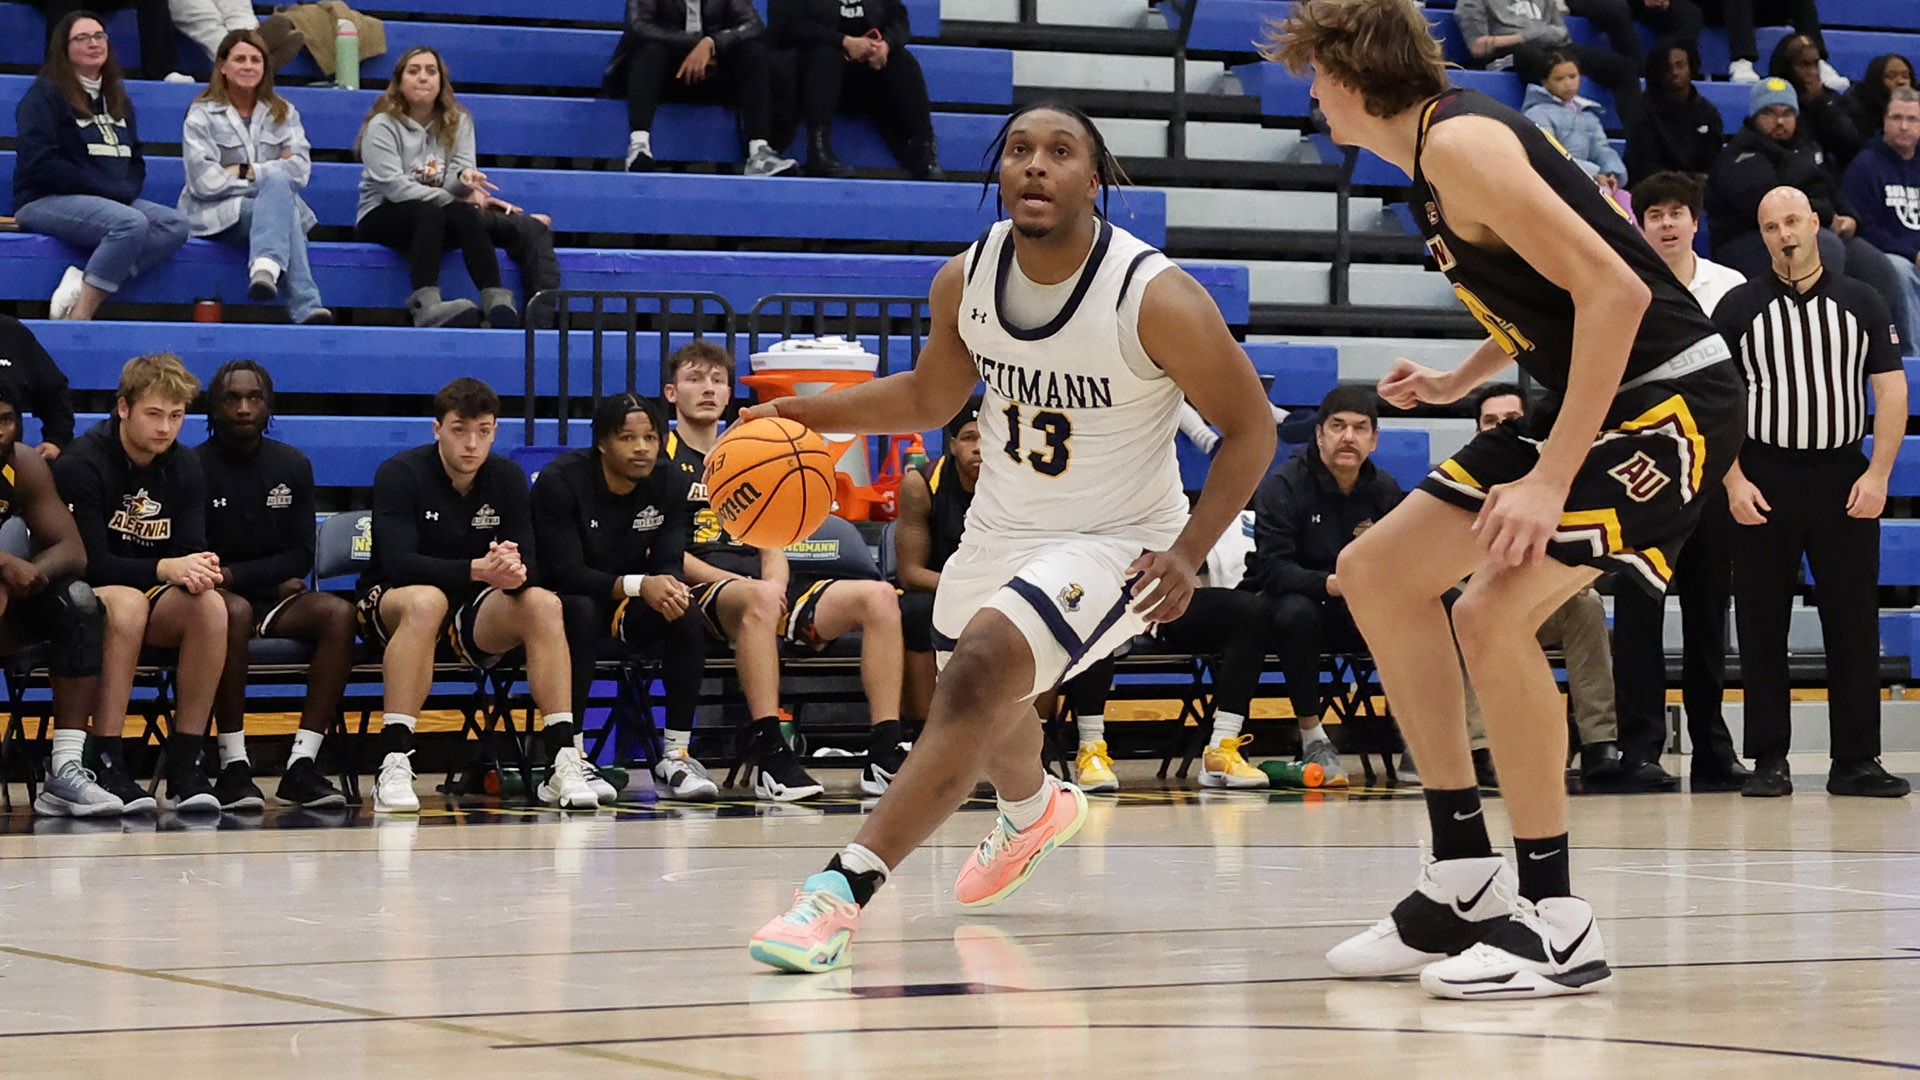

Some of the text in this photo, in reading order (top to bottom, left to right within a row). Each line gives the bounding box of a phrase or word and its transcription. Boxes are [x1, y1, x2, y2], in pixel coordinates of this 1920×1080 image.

[1003, 400, 1072, 478] 13
[1609, 452, 1669, 501] AU
[719, 482, 763, 521] Wils
